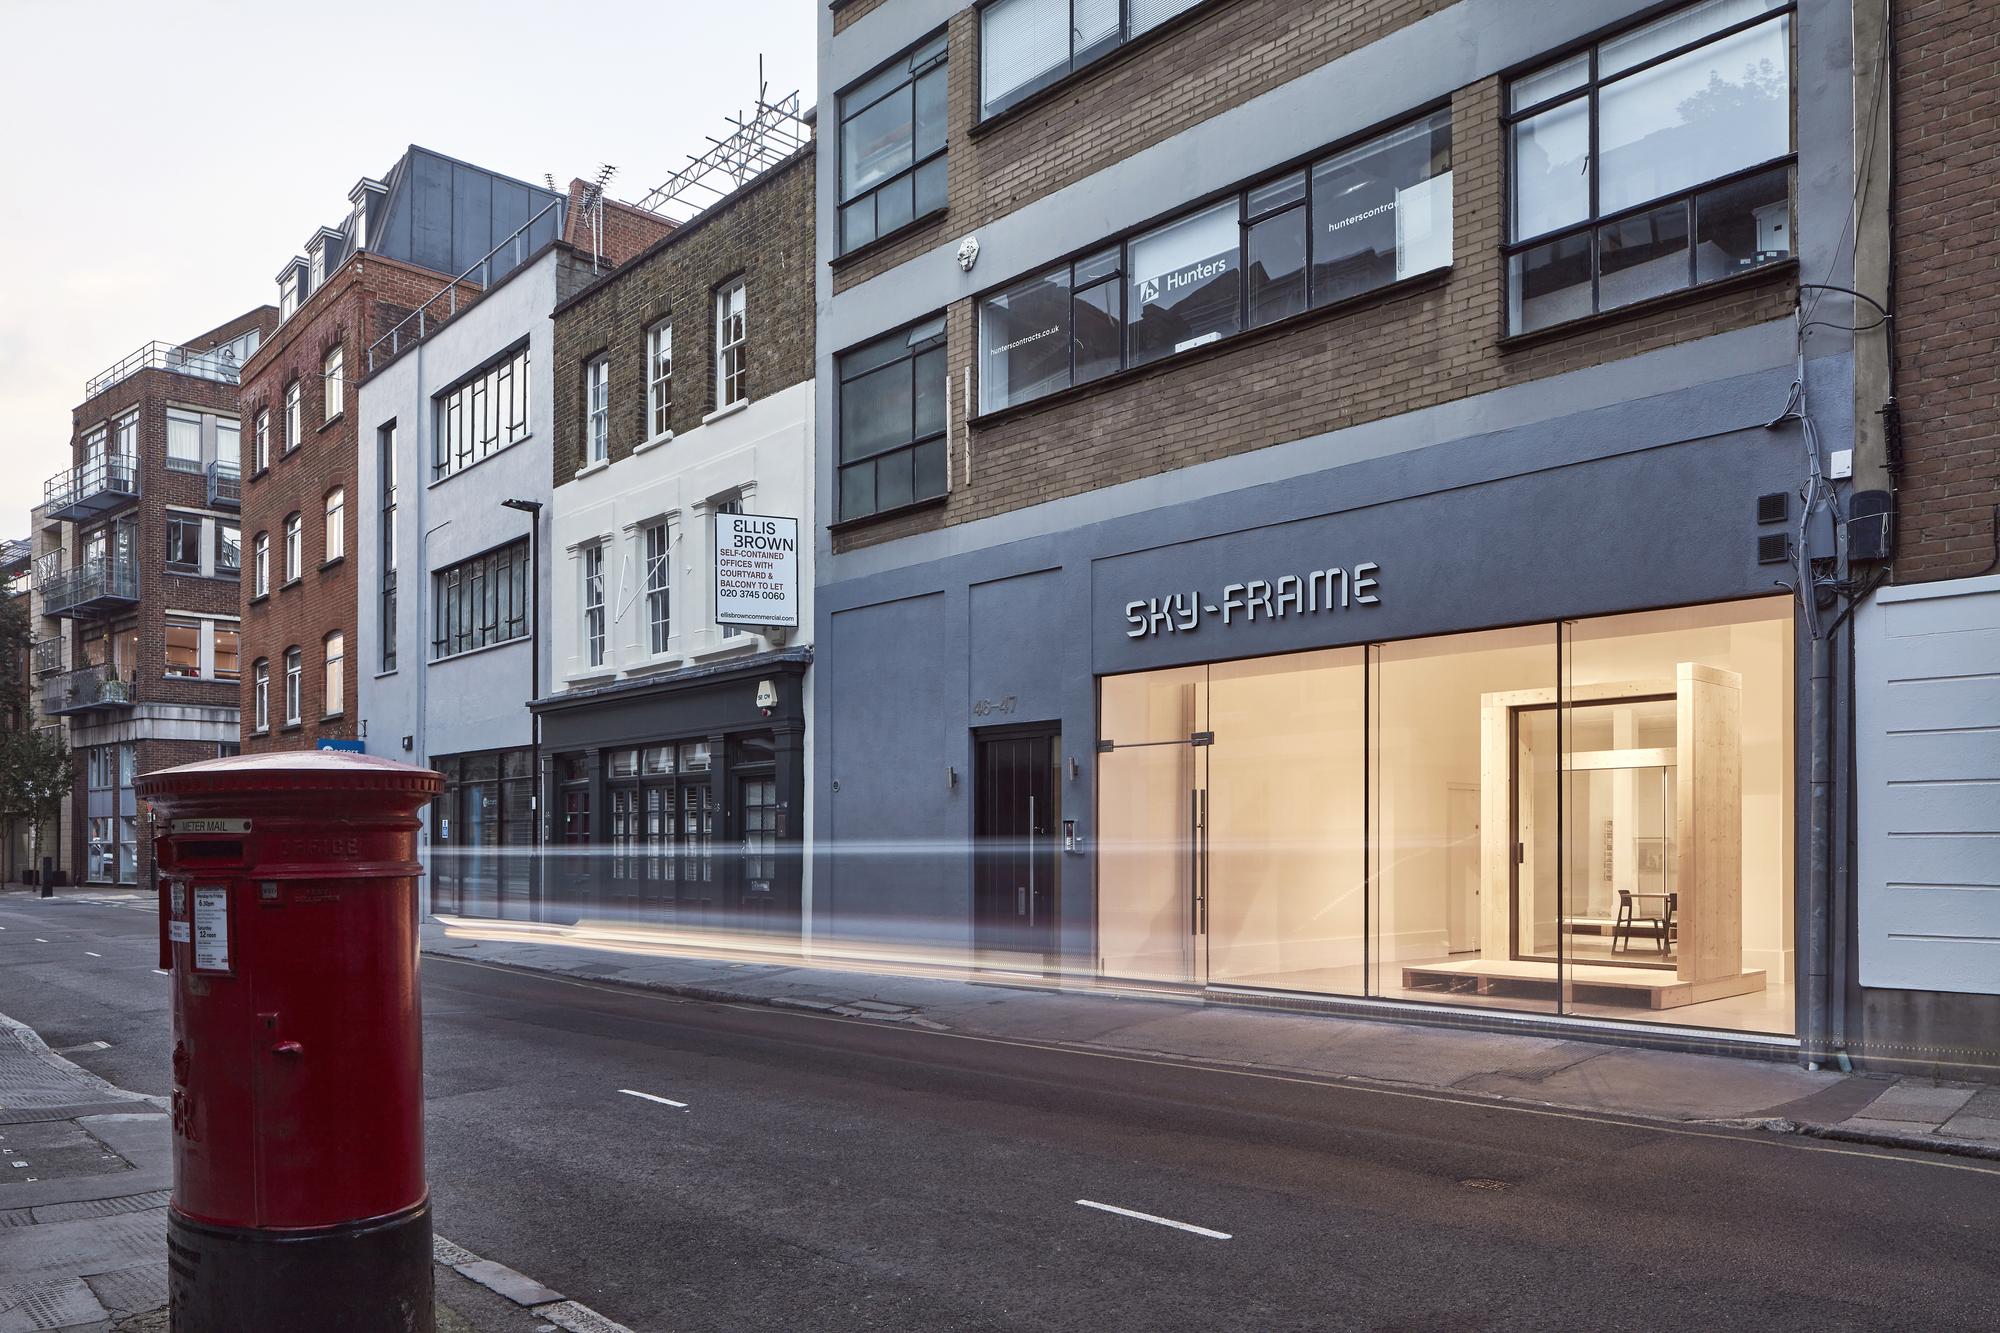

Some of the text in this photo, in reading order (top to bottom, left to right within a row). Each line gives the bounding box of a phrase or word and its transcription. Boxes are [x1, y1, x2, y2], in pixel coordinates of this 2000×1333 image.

[1167, 259, 1226, 291] Hunters
[990, 325, 1060, 356] hunterscontracts.co.uk
[733, 519, 776, 535] ELLIS
[734, 534, 794, 552] BROWN
[720, 548, 784, 560] SELF-CONTAINED
[720, 559, 773, 569] OFFICES WITH
[720, 569, 774, 580] COURTYARD &
[720, 580, 784, 591] BALCONY TO LET
[720, 588, 785, 601] 020 3745 0060
[1125, 561, 1381, 639] SKY-FRAME
[720, 611, 795, 622] ellisbrowncommercial.com
[207, 821, 228, 832] MAIL
